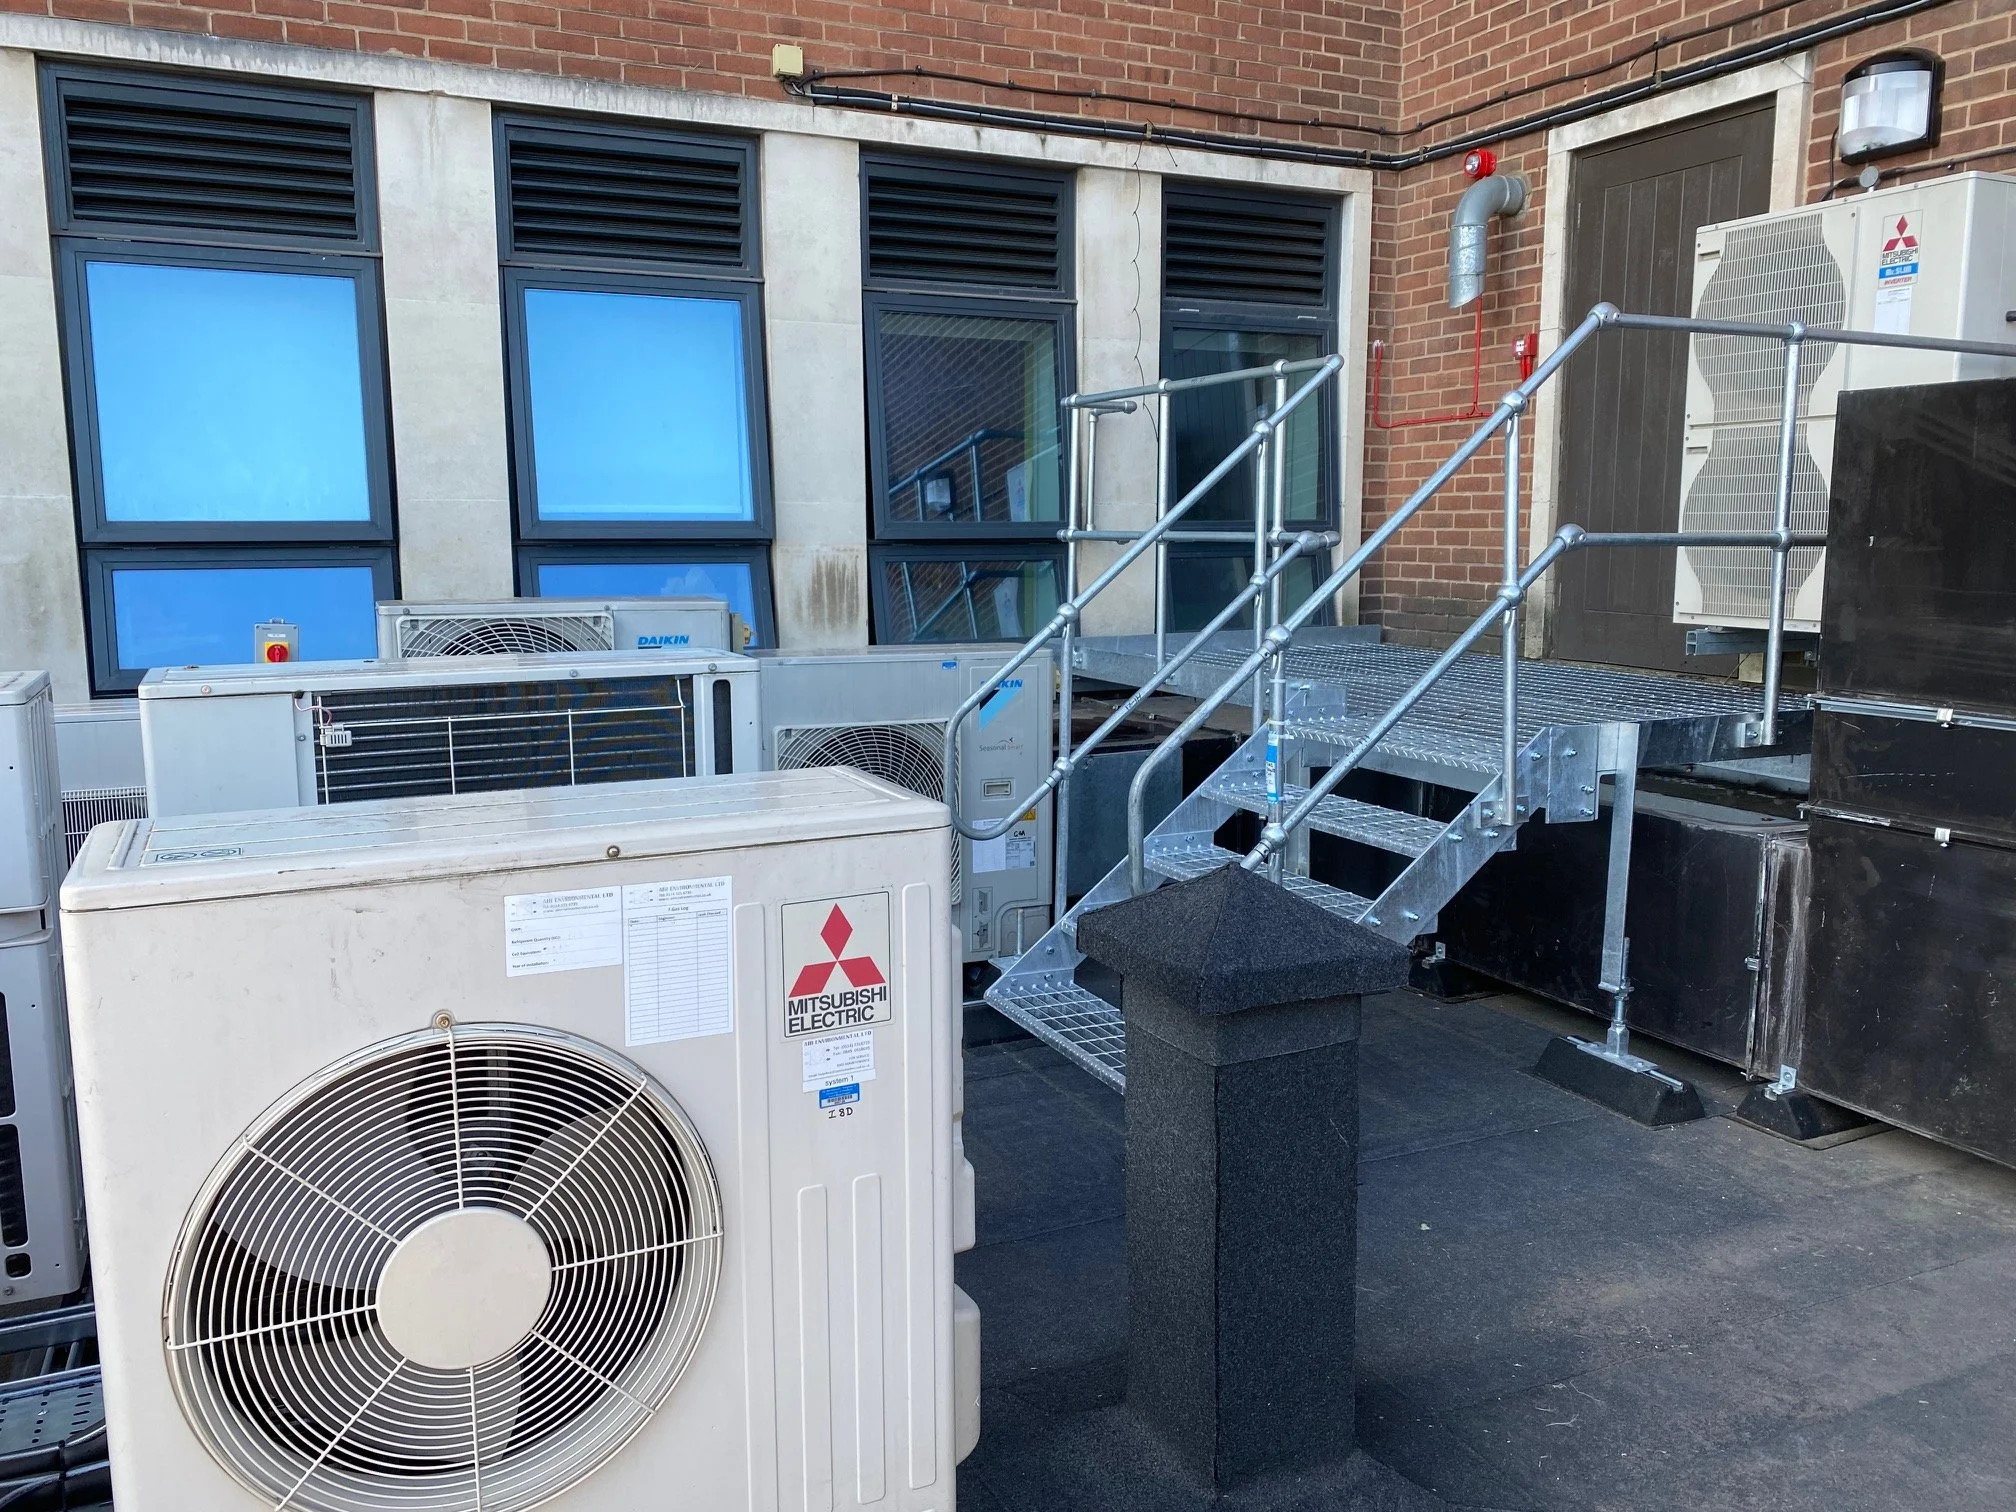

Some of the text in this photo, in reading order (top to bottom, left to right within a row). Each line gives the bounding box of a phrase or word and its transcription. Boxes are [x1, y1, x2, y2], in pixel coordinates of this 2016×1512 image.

[1883, 247, 1919, 259] MITSUBISHI
[1882, 256, 1913, 266] ELECTRIC
[637, 635, 690, 645] DAIKIN
[788, 985, 887, 1017] MITSUBISHI
[788, 1005, 874, 1034] ELECTRIC
[825, 1076, 849, 1087] system
